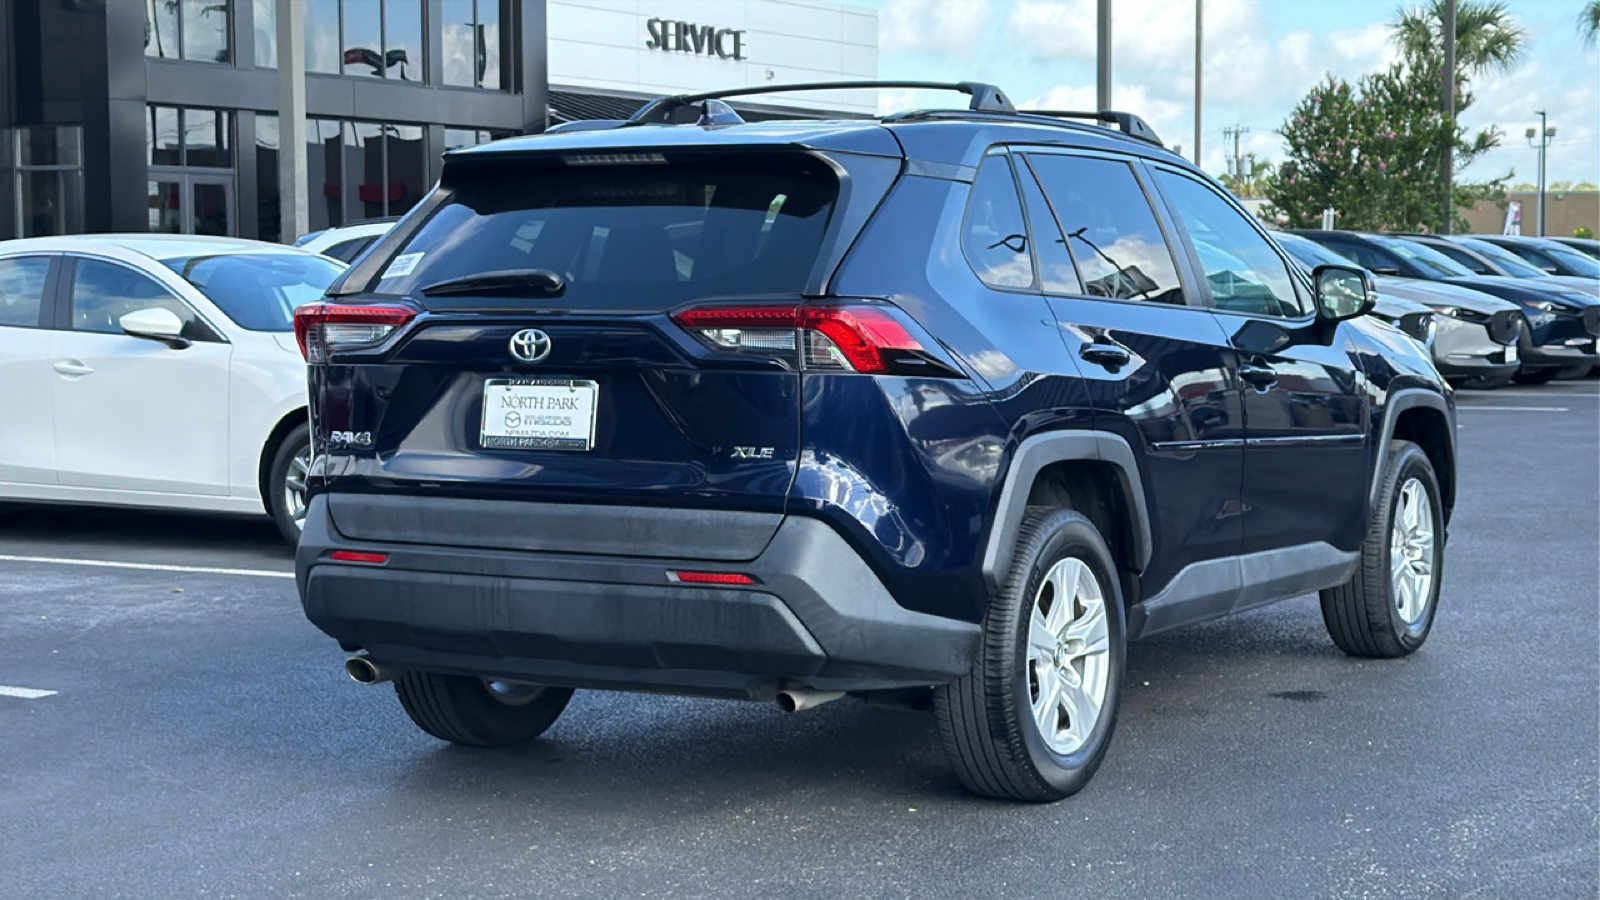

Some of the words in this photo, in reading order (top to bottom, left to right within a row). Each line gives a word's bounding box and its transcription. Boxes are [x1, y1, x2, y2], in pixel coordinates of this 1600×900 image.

[646, 17, 748, 60] SERVICE
[500, 394, 544, 410] NORTH
[547, 396, 580, 410] PARK
[330, 430, 372, 446] RAV4
[730, 445, 775, 459] XLE
